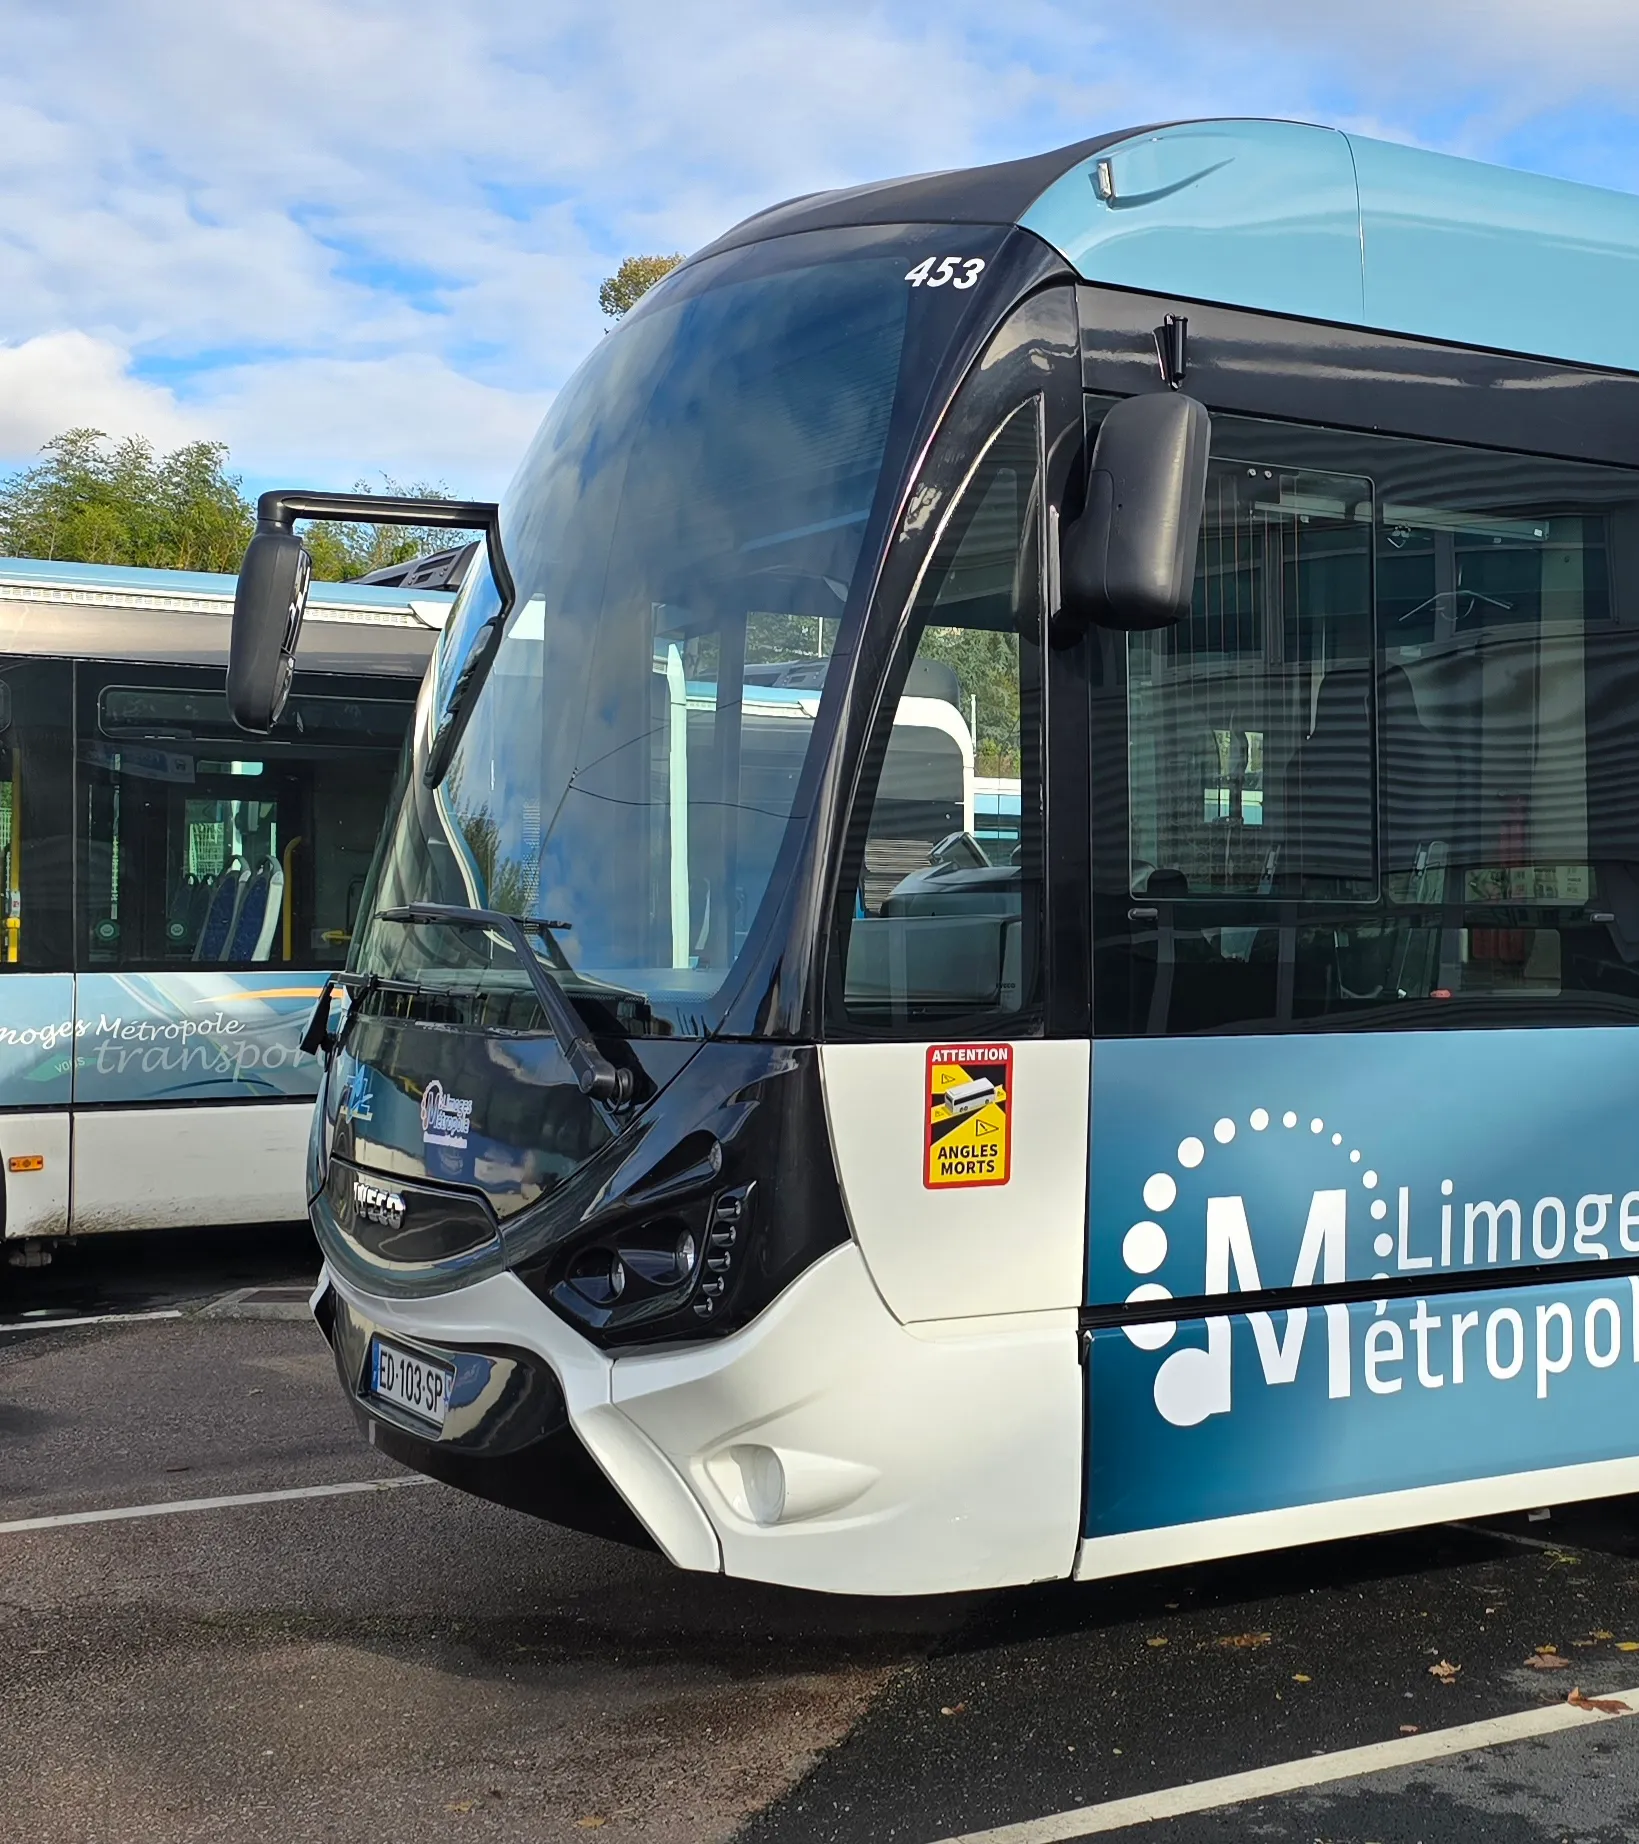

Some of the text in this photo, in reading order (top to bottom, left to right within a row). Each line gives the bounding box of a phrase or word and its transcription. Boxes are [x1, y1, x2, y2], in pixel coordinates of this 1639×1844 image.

[904, 256, 986, 290] 453
[96, 1012, 246, 1045] Métropole
[931, 1047, 1009, 1062] ATTENTION
[442, 1093, 473, 1117] Limoges
[938, 1144, 999, 1160] ANGLES
[940, 1160, 996, 1176] MORTS
[353, 1181, 407, 1230] IVECO
[379, 1349, 443, 1413] ED-103-SP
